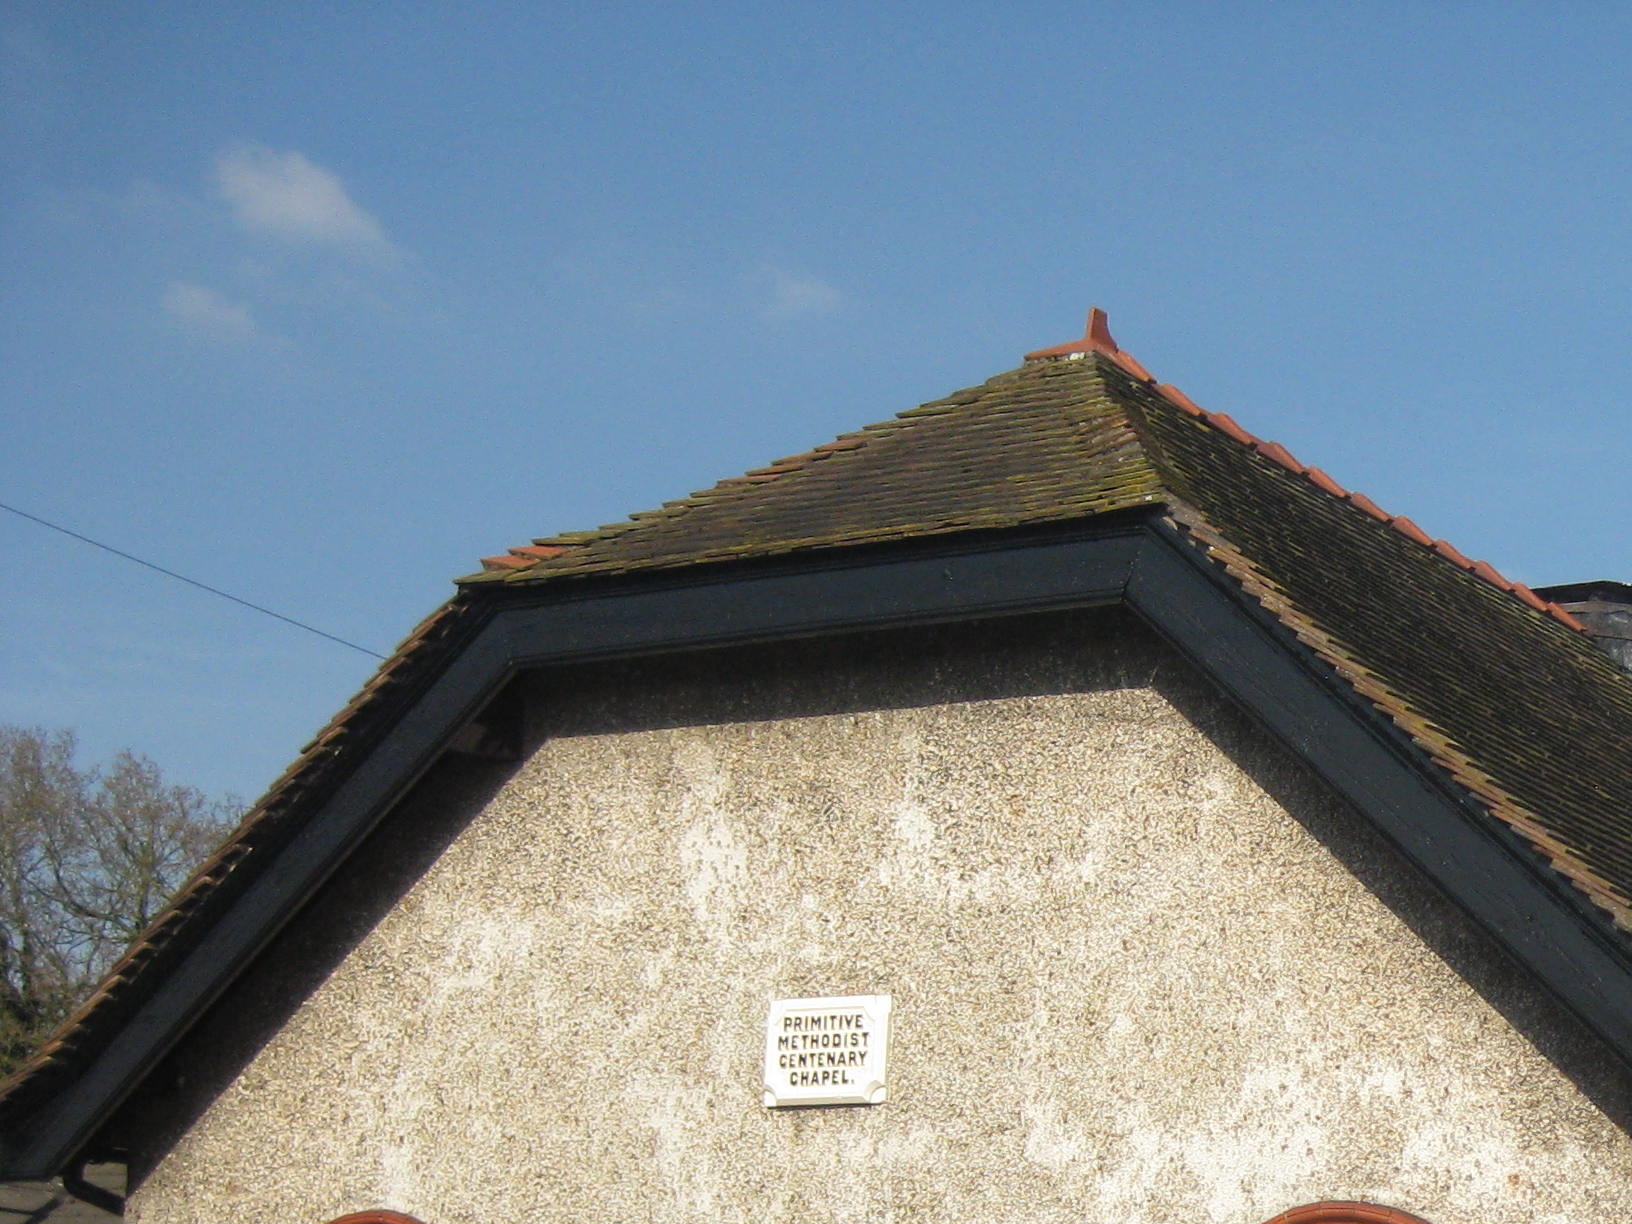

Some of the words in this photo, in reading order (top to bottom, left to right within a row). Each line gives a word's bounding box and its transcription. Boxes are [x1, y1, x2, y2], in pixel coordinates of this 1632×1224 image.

[783, 1014, 864, 1032] PRIMITIVE
[778, 1032, 869, 1050] METHODIST
[779, 1051, 868, 1068] CENTENARY
